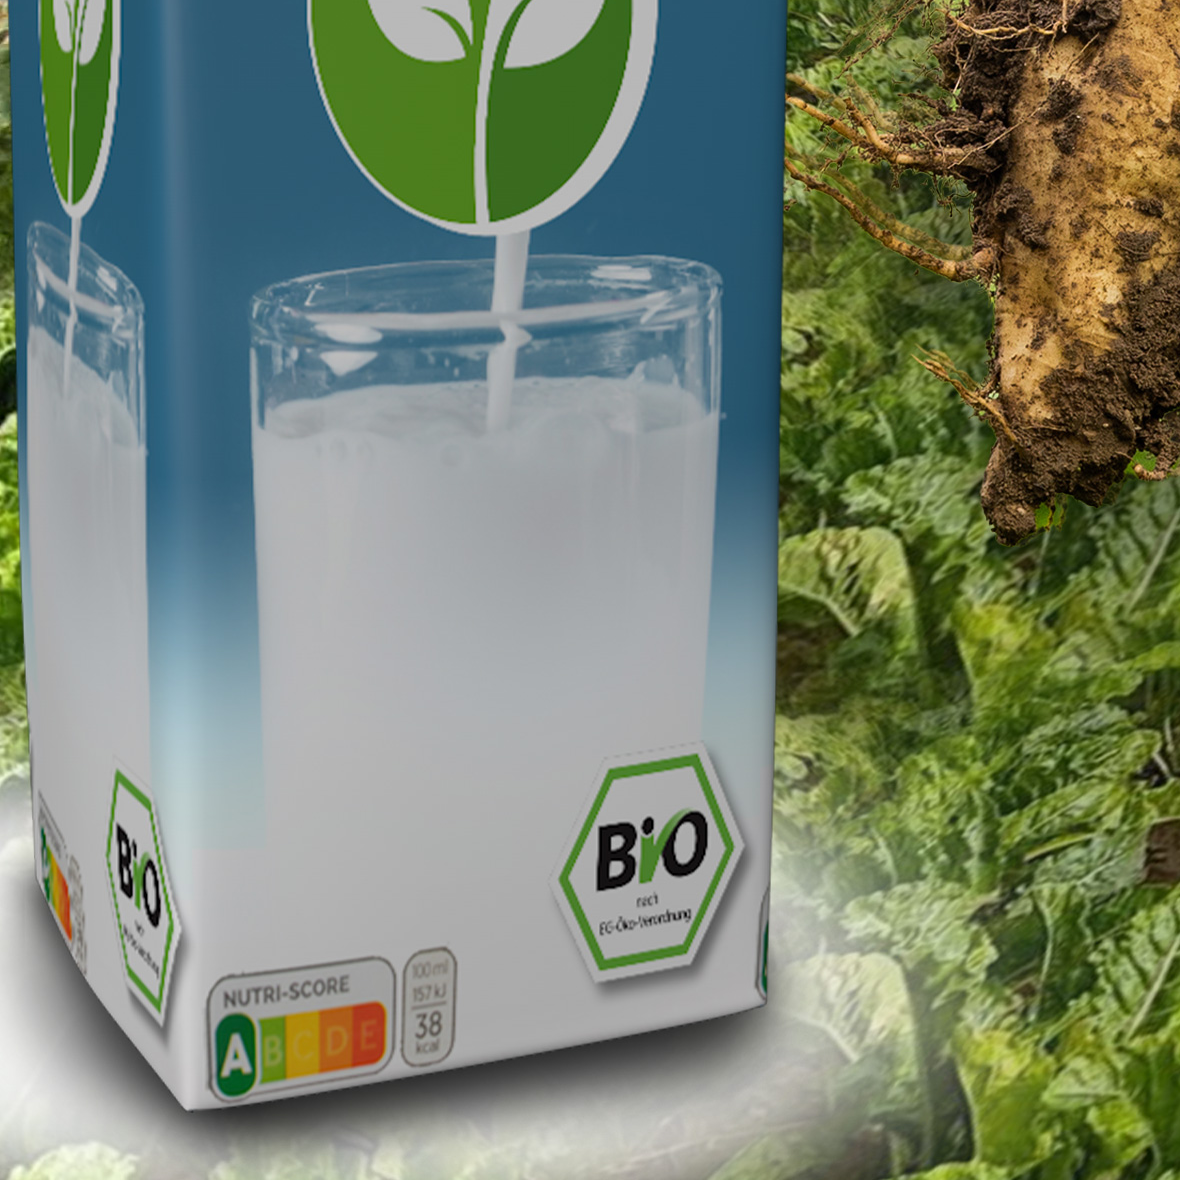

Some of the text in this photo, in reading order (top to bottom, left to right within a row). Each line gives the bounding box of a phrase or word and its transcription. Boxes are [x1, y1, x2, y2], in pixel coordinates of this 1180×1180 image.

[412, 961, 431, 979] 100
[223, 975, 350, 1008] NUTRI-SCORE
[412, 985, 432, 1002] 157
[415, 1010, 442, 1039] 38
[220, 1020, 377, 1078] A B C D E
[416, 1038, 439, 1054] kcal
